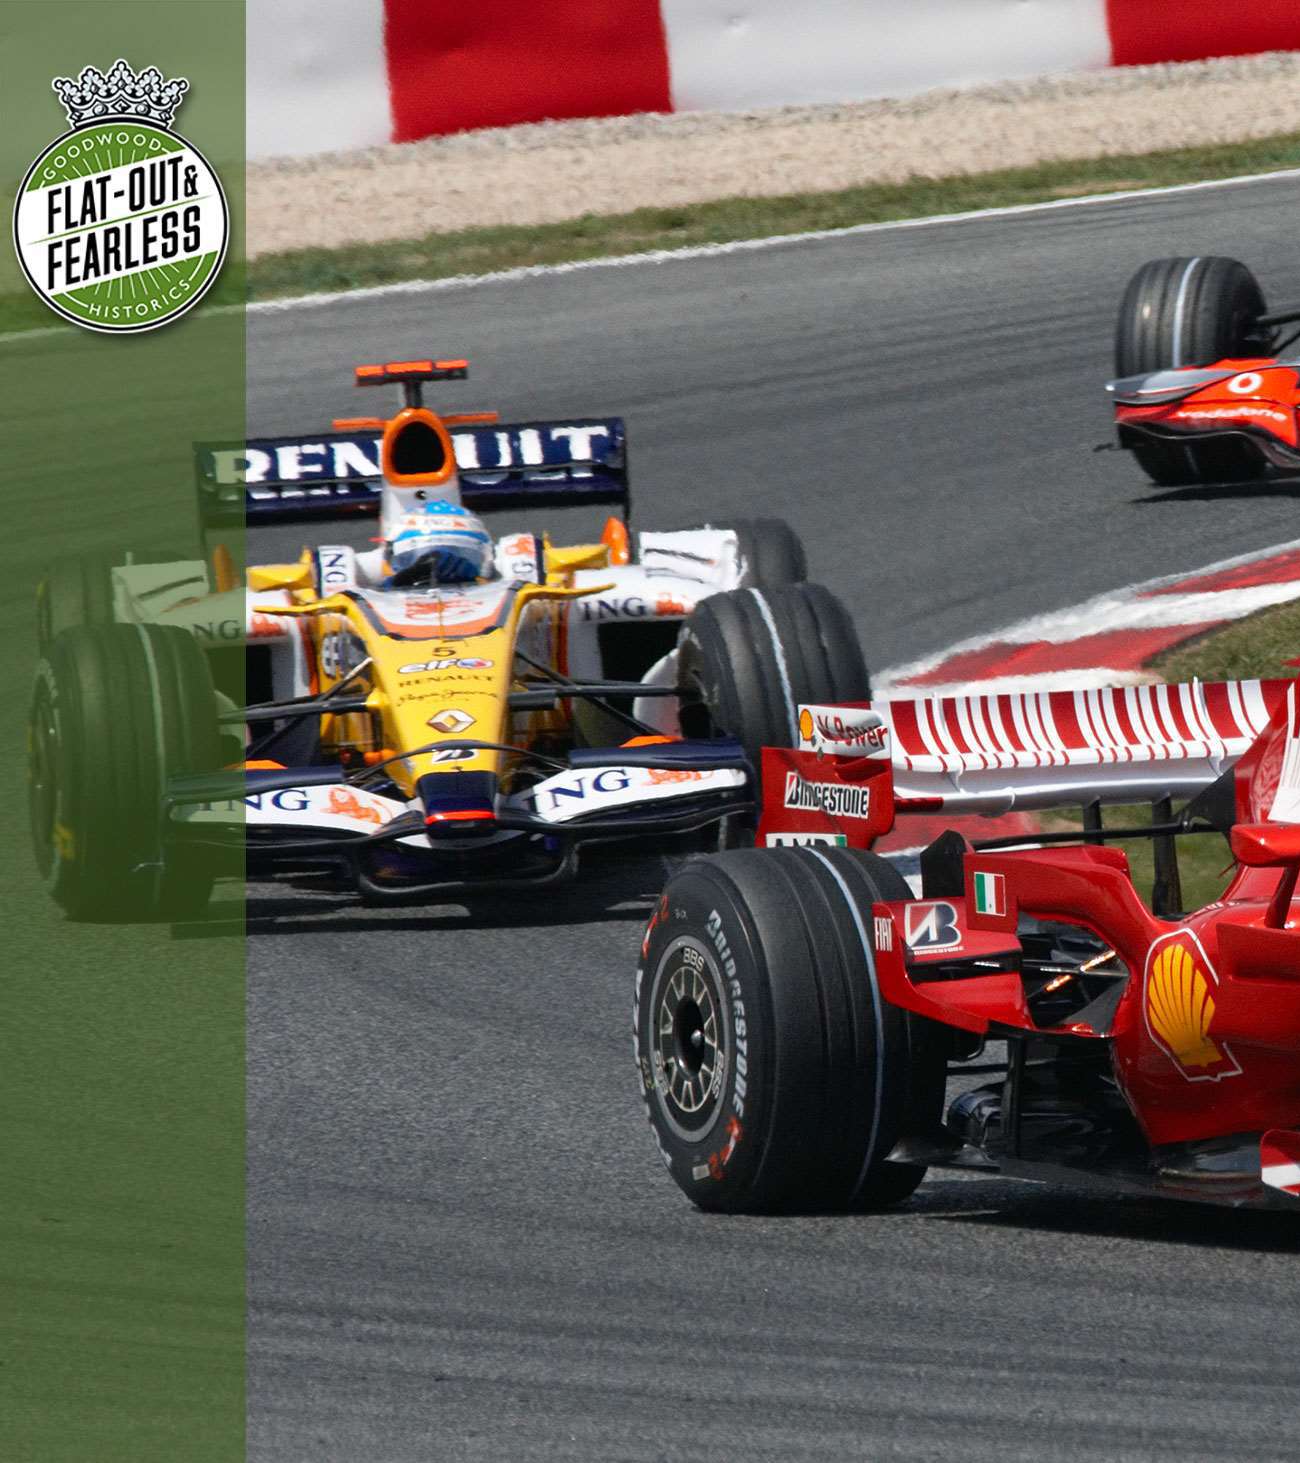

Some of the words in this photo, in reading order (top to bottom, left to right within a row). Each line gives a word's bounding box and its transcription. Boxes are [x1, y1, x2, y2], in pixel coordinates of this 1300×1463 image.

[1176, 406, 1288, 422] vodafone
[211, 425, 609, 500] RENULT
[577, 597, 647, 622] ING
[191, 619, 241, 641] NG
[431, 646, 457, 657] 5
[786, 773, 869, 817] BRIDGESTONE
[683, 947, 705, 972] BBS
[704, 908, 748, 1119] BRIDGESTONE
